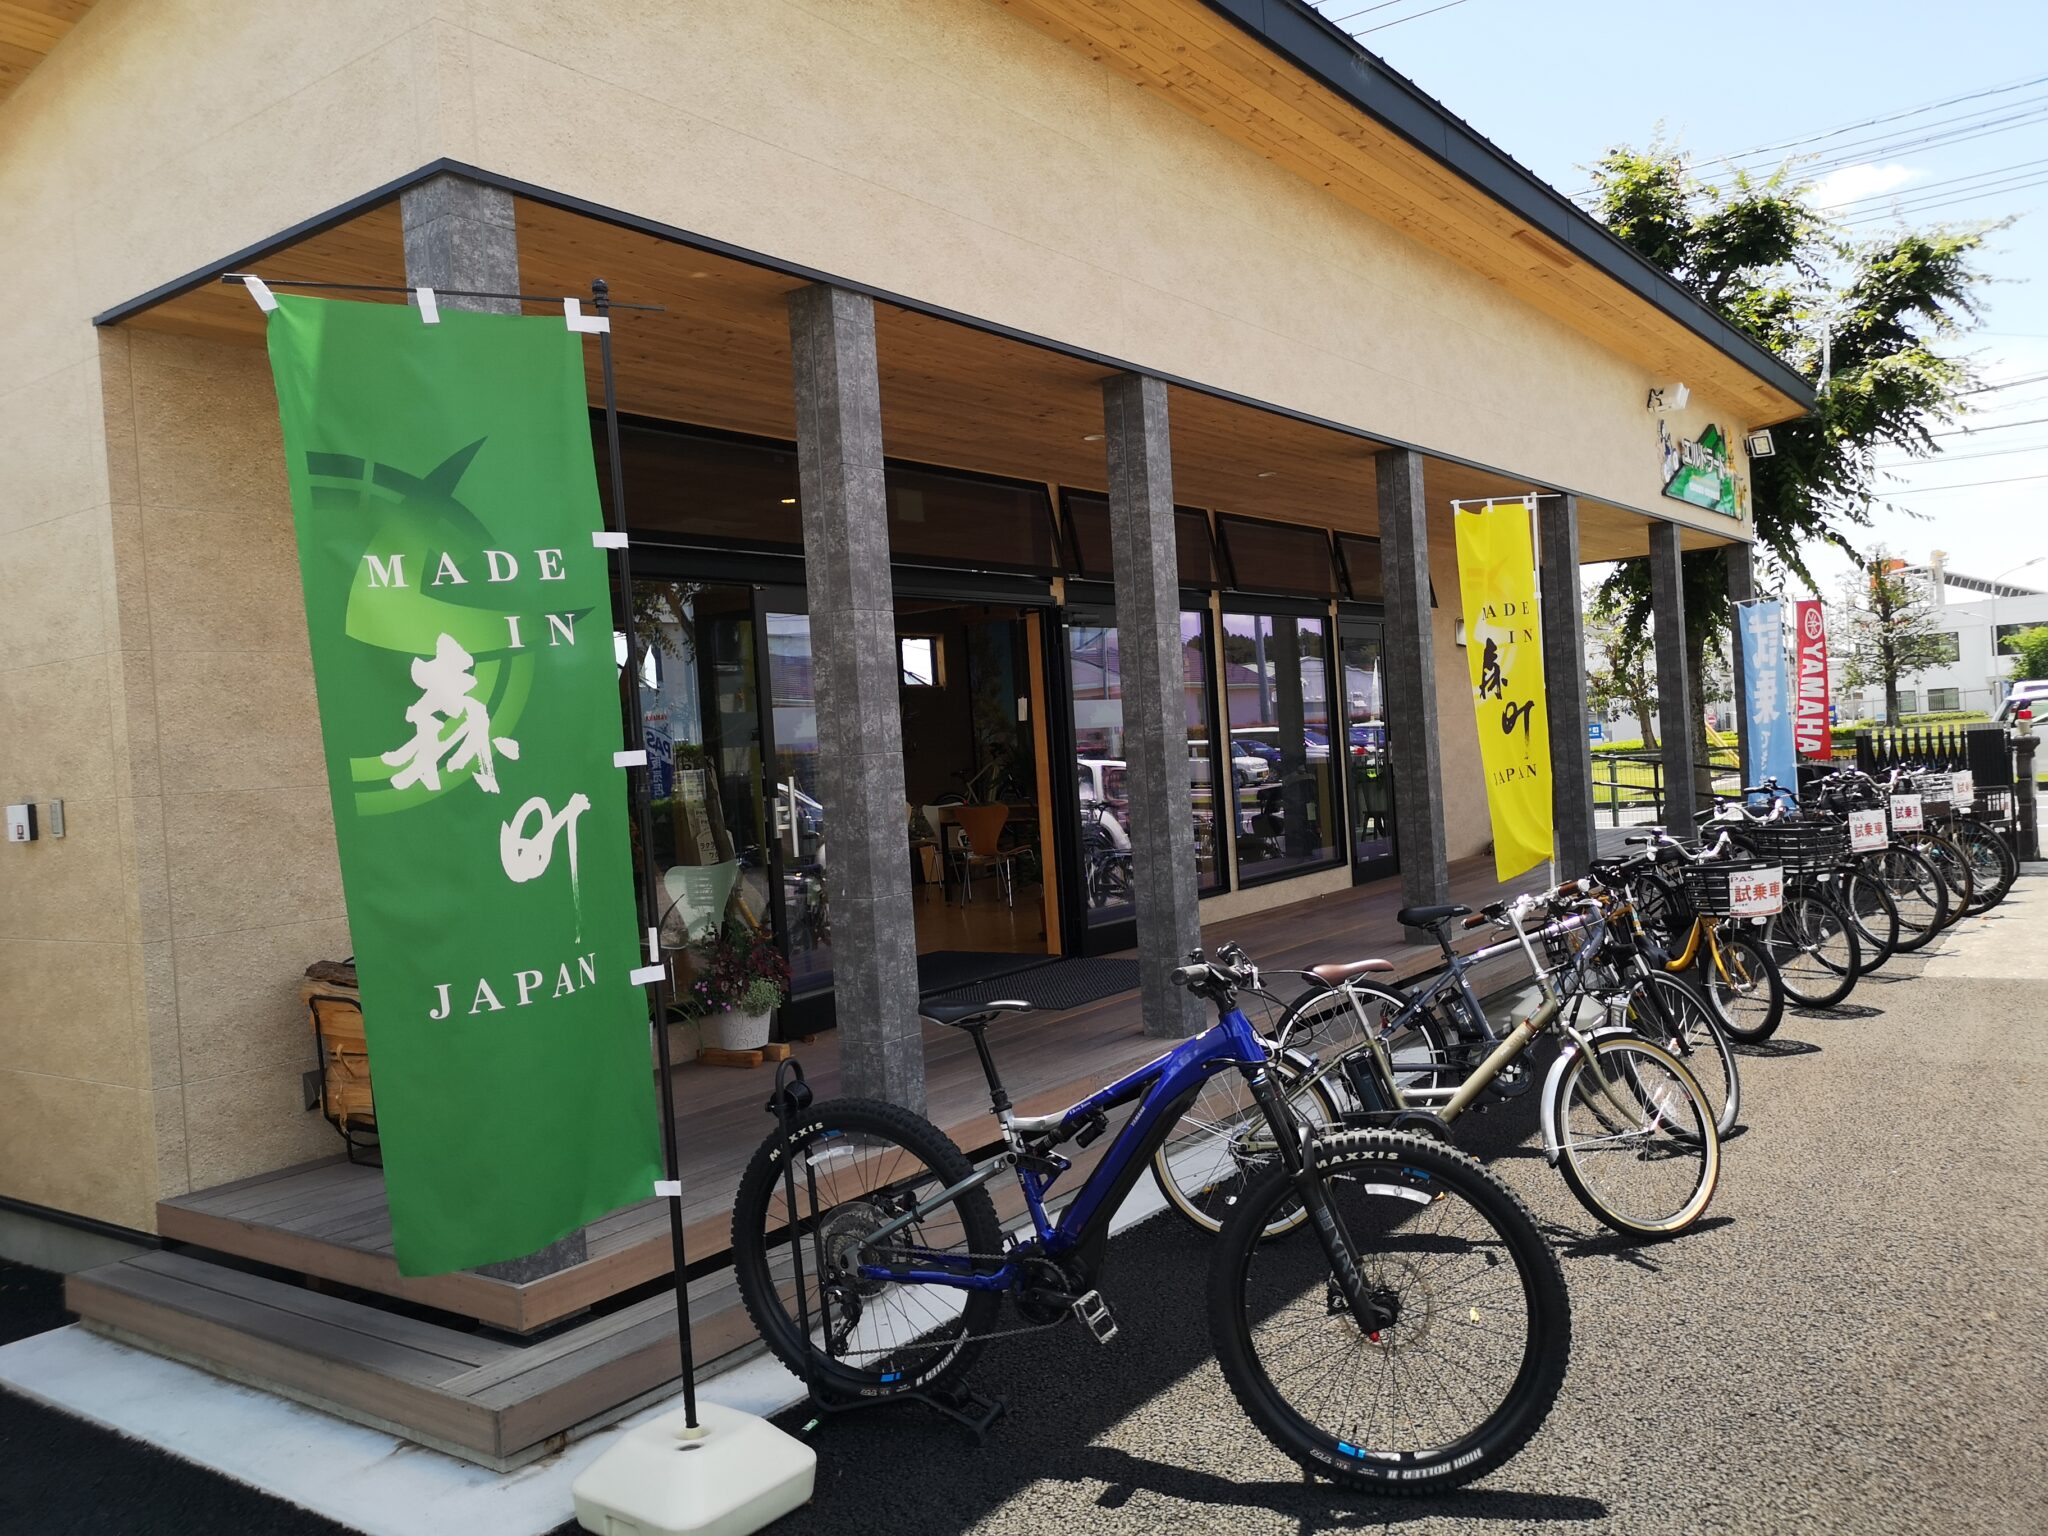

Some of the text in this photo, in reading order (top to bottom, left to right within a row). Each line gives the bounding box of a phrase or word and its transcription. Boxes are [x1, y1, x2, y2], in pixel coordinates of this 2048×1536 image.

[363, 548, 566, 588] MADE
[504, 613, 575, 649] IN
[1509, 628, 1533, 643] IN
[1798, 642, 1825, 753] YAMAHA
[1854, 821, 1883, 838] 試乗車
[1735, 881, 1780, 902] 試乗車
[429, 953, 596, 1020] JAPAN
[769, 1122, 824, 1162] MXXIS
[1316, 1151, 1399, 1169] MAXXIS
